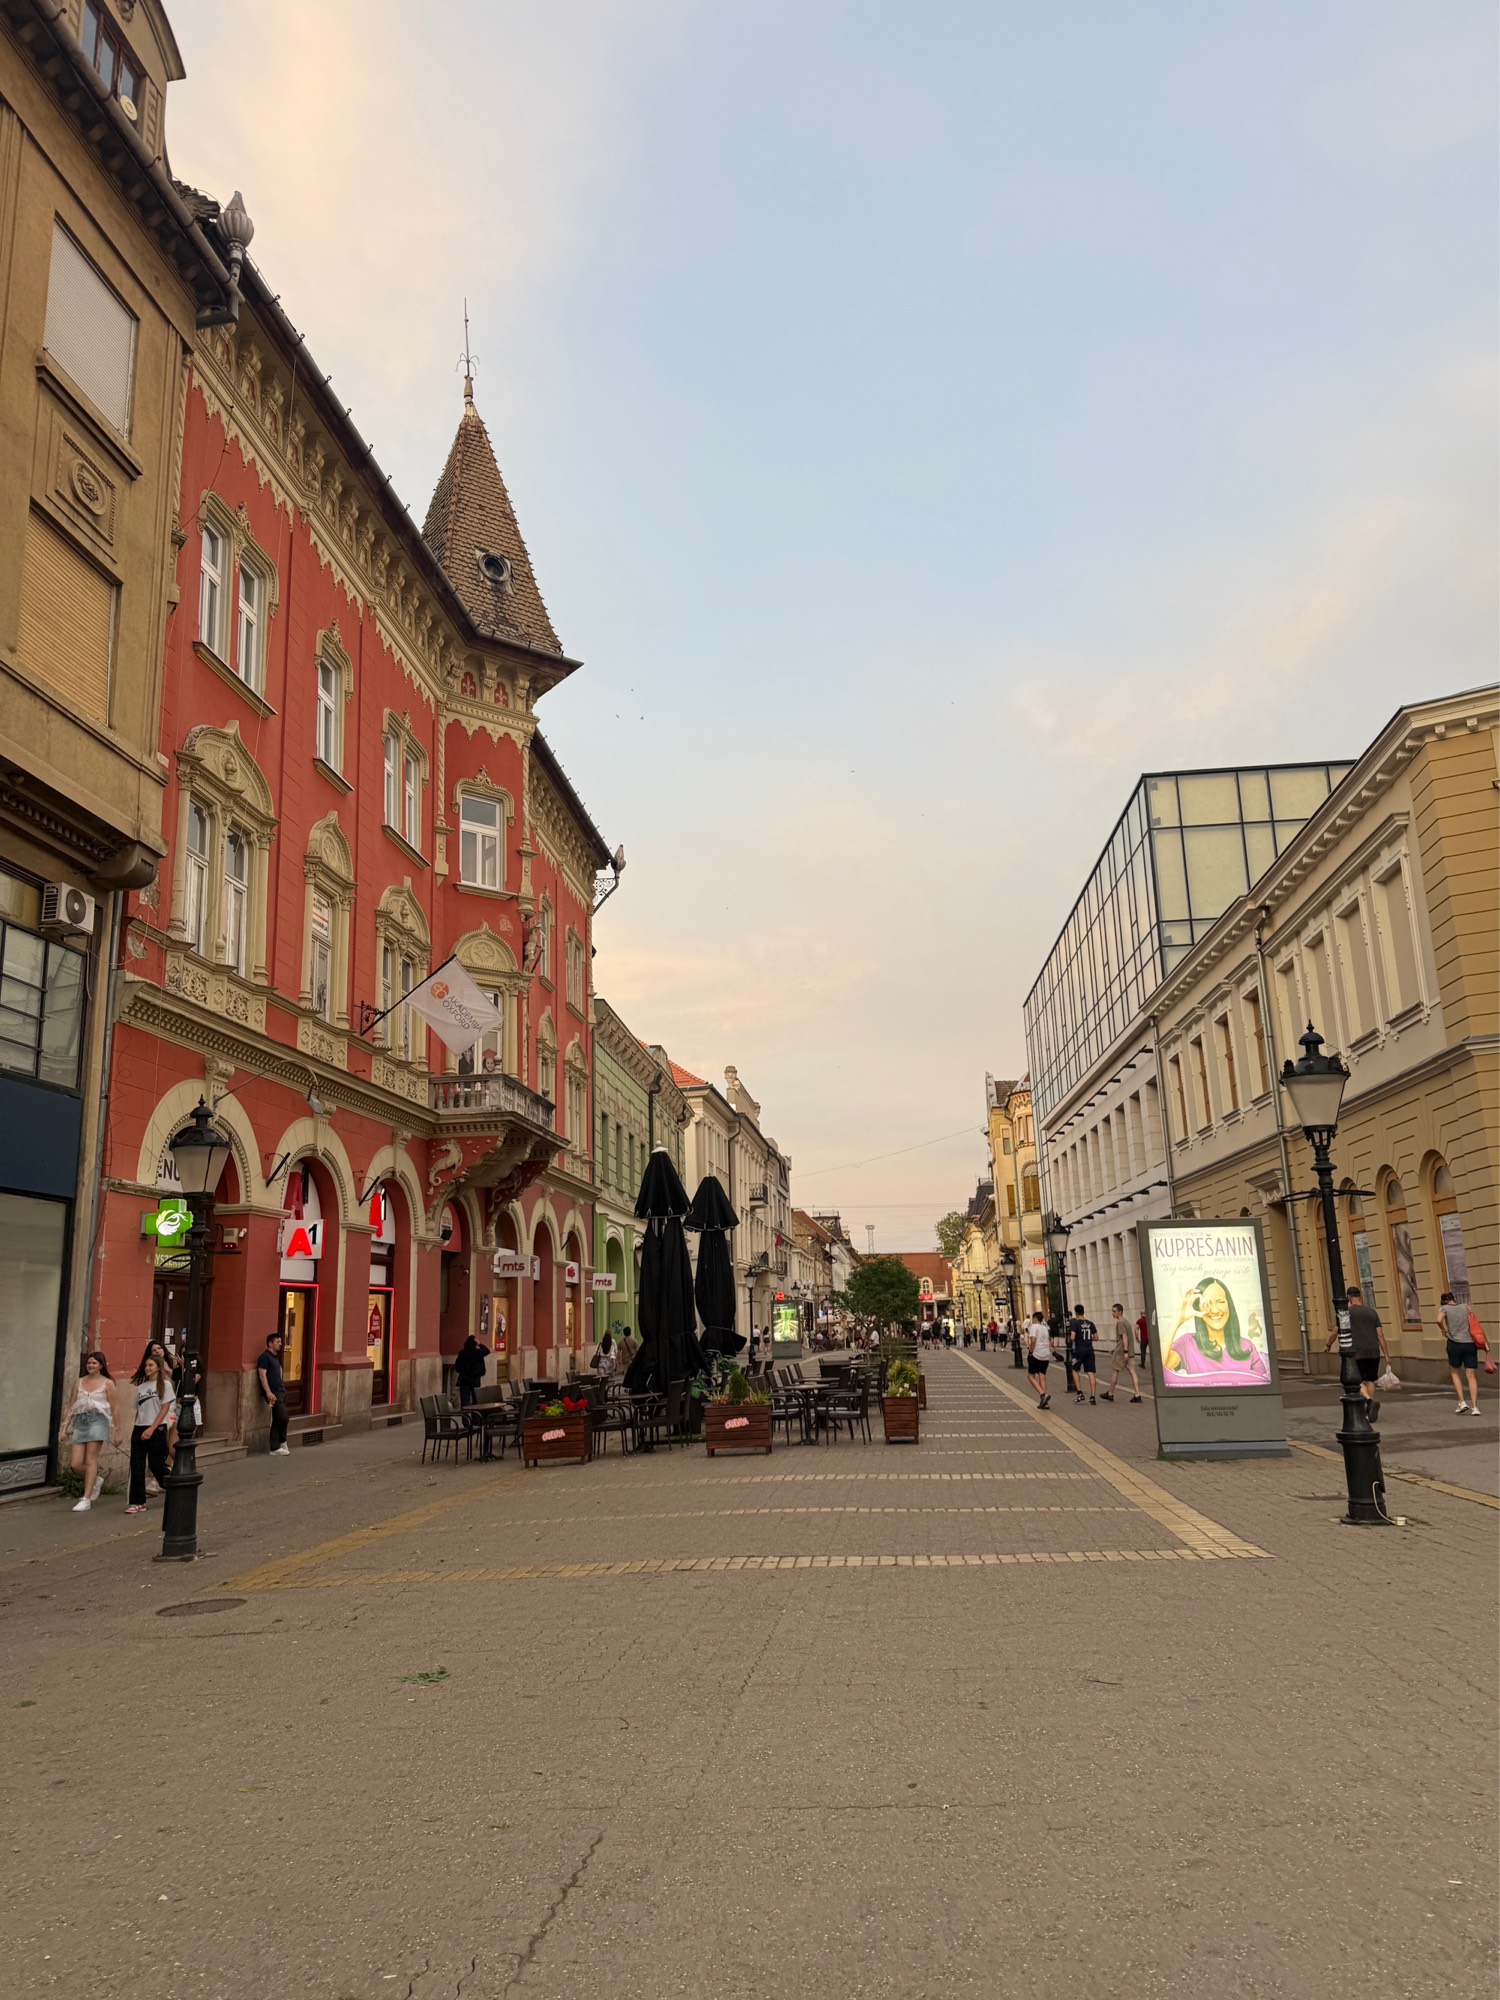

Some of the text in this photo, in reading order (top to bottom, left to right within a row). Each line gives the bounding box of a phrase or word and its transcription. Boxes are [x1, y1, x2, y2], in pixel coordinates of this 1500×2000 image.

[442, 1000, 471, 1030] OXFORD
[448, 995, 483, 1033] AKADEMIJA
[286, 1223, 318, 1257] A1
[1154, 1233, 1254, 1258] KUPREŠANIN
[502, 1261, 525, 1272] mts
[594, 1278, 612, 1287] mts
[1081, 1328, 1091, 1340] 77
